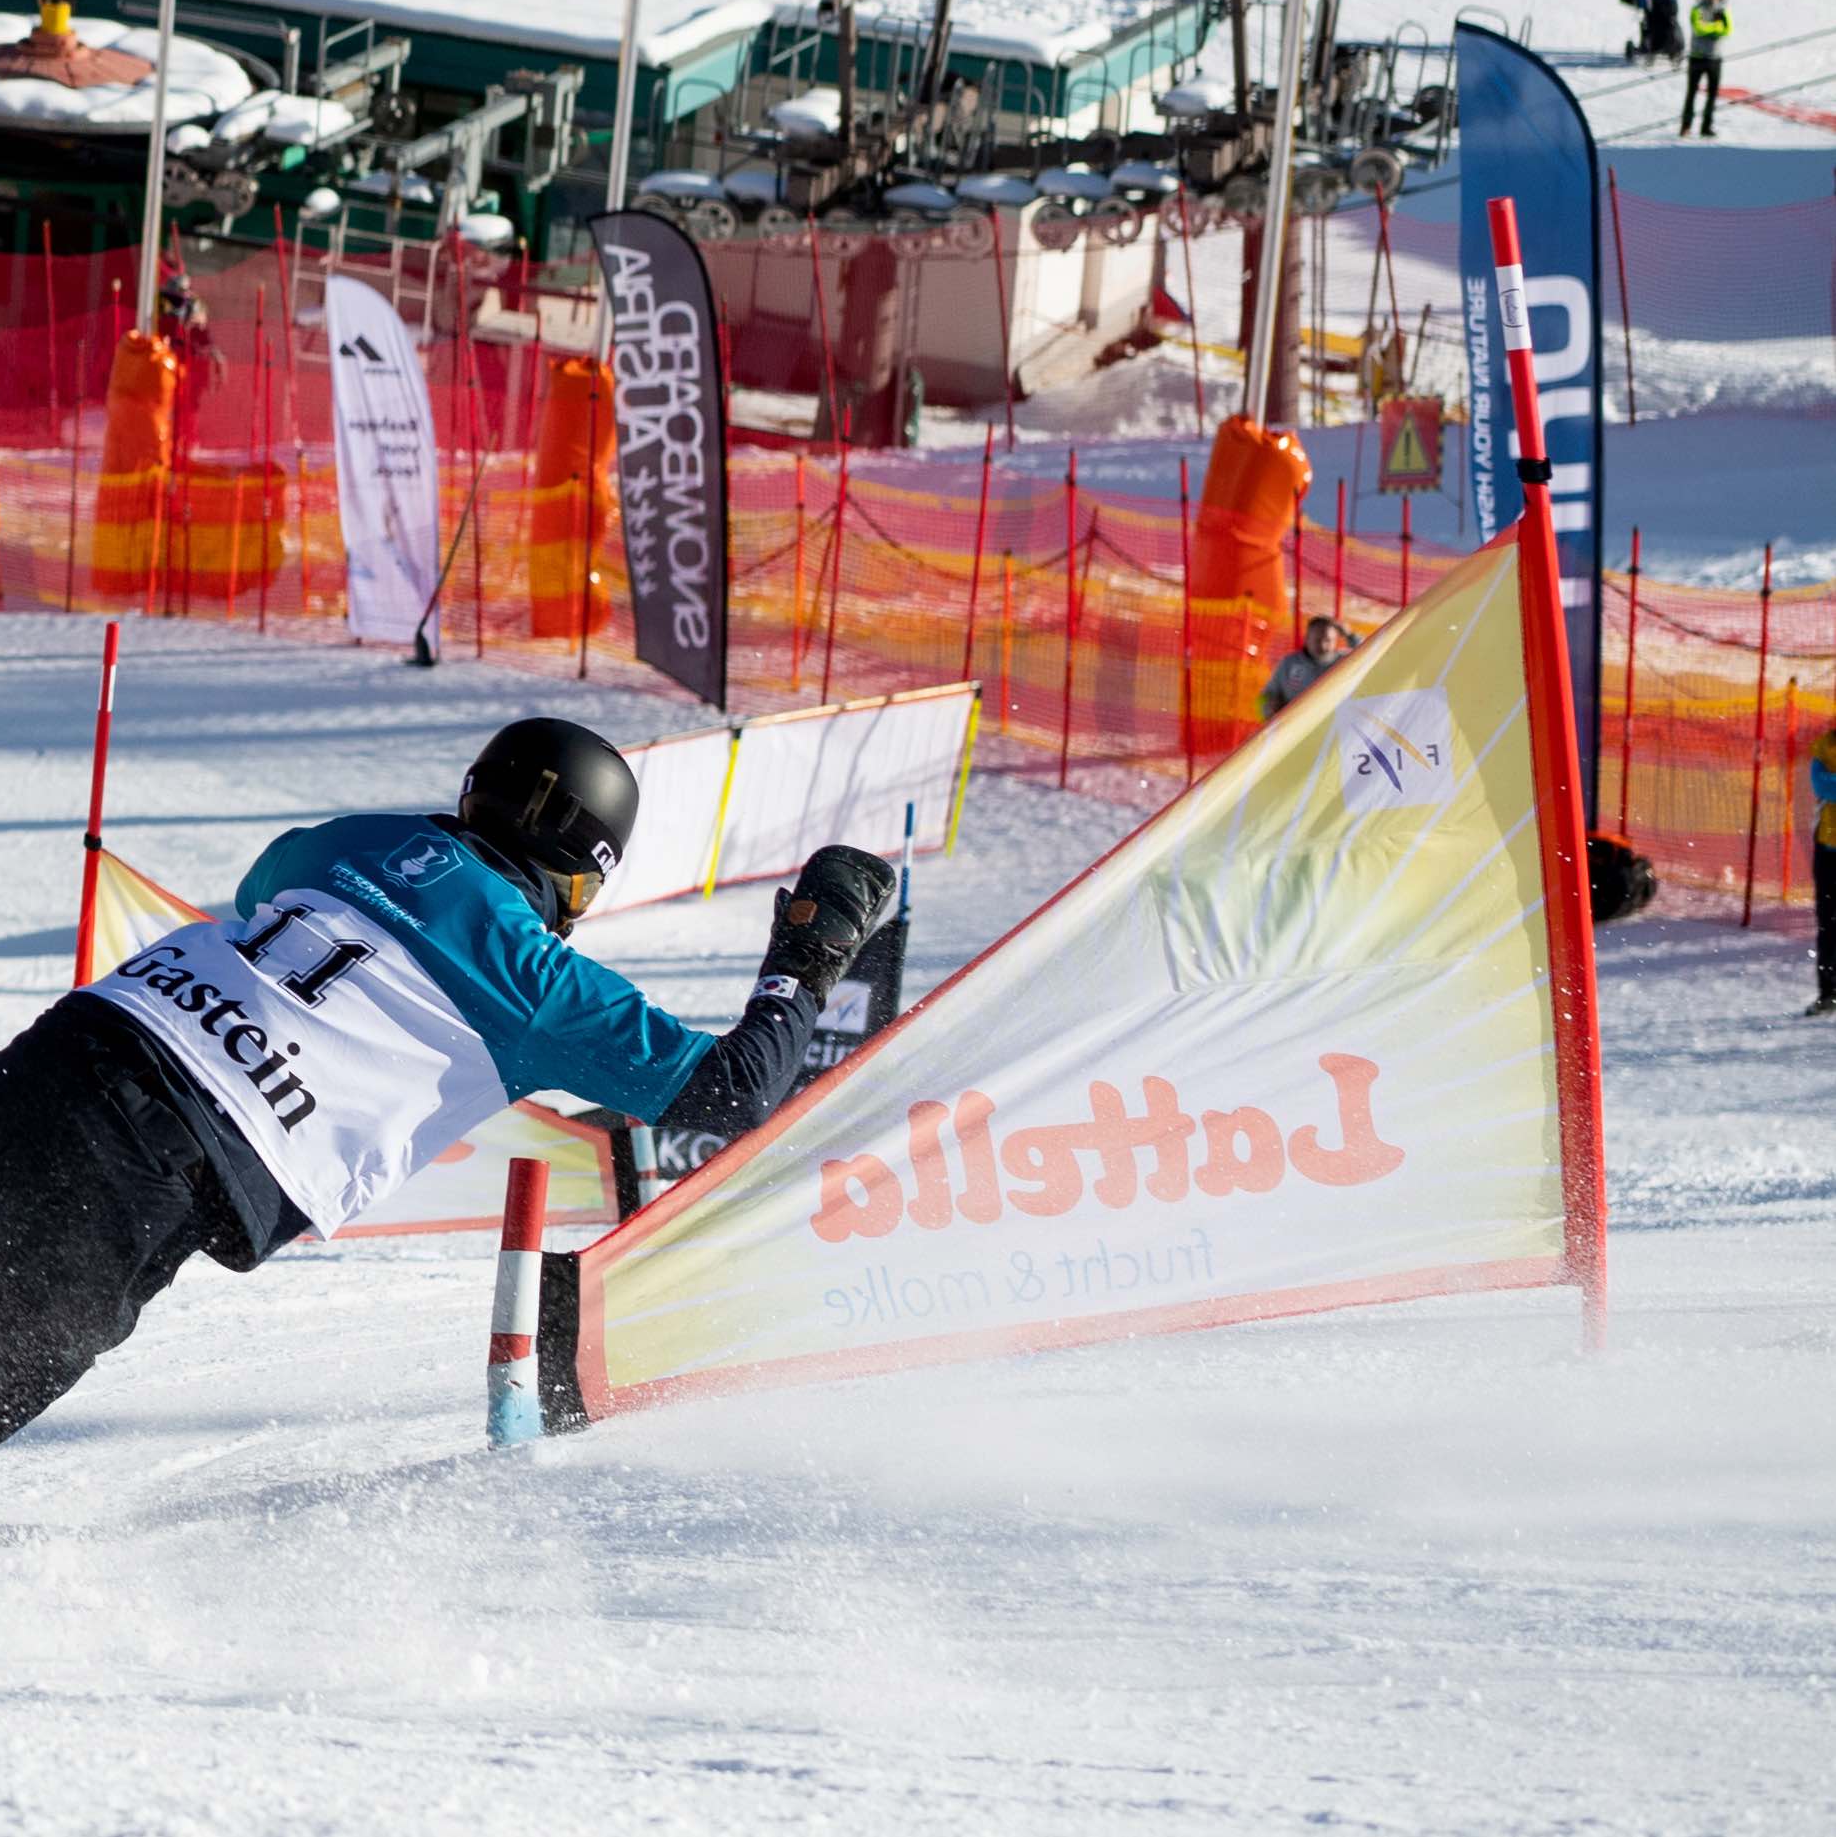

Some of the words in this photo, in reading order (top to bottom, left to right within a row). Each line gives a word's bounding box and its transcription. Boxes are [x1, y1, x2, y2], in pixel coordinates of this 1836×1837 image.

[328, 864, 427, 932] FELSENTHERME
[227, 902, 378, 1010] 11
[116, 946, 317, 1135] Gastein
